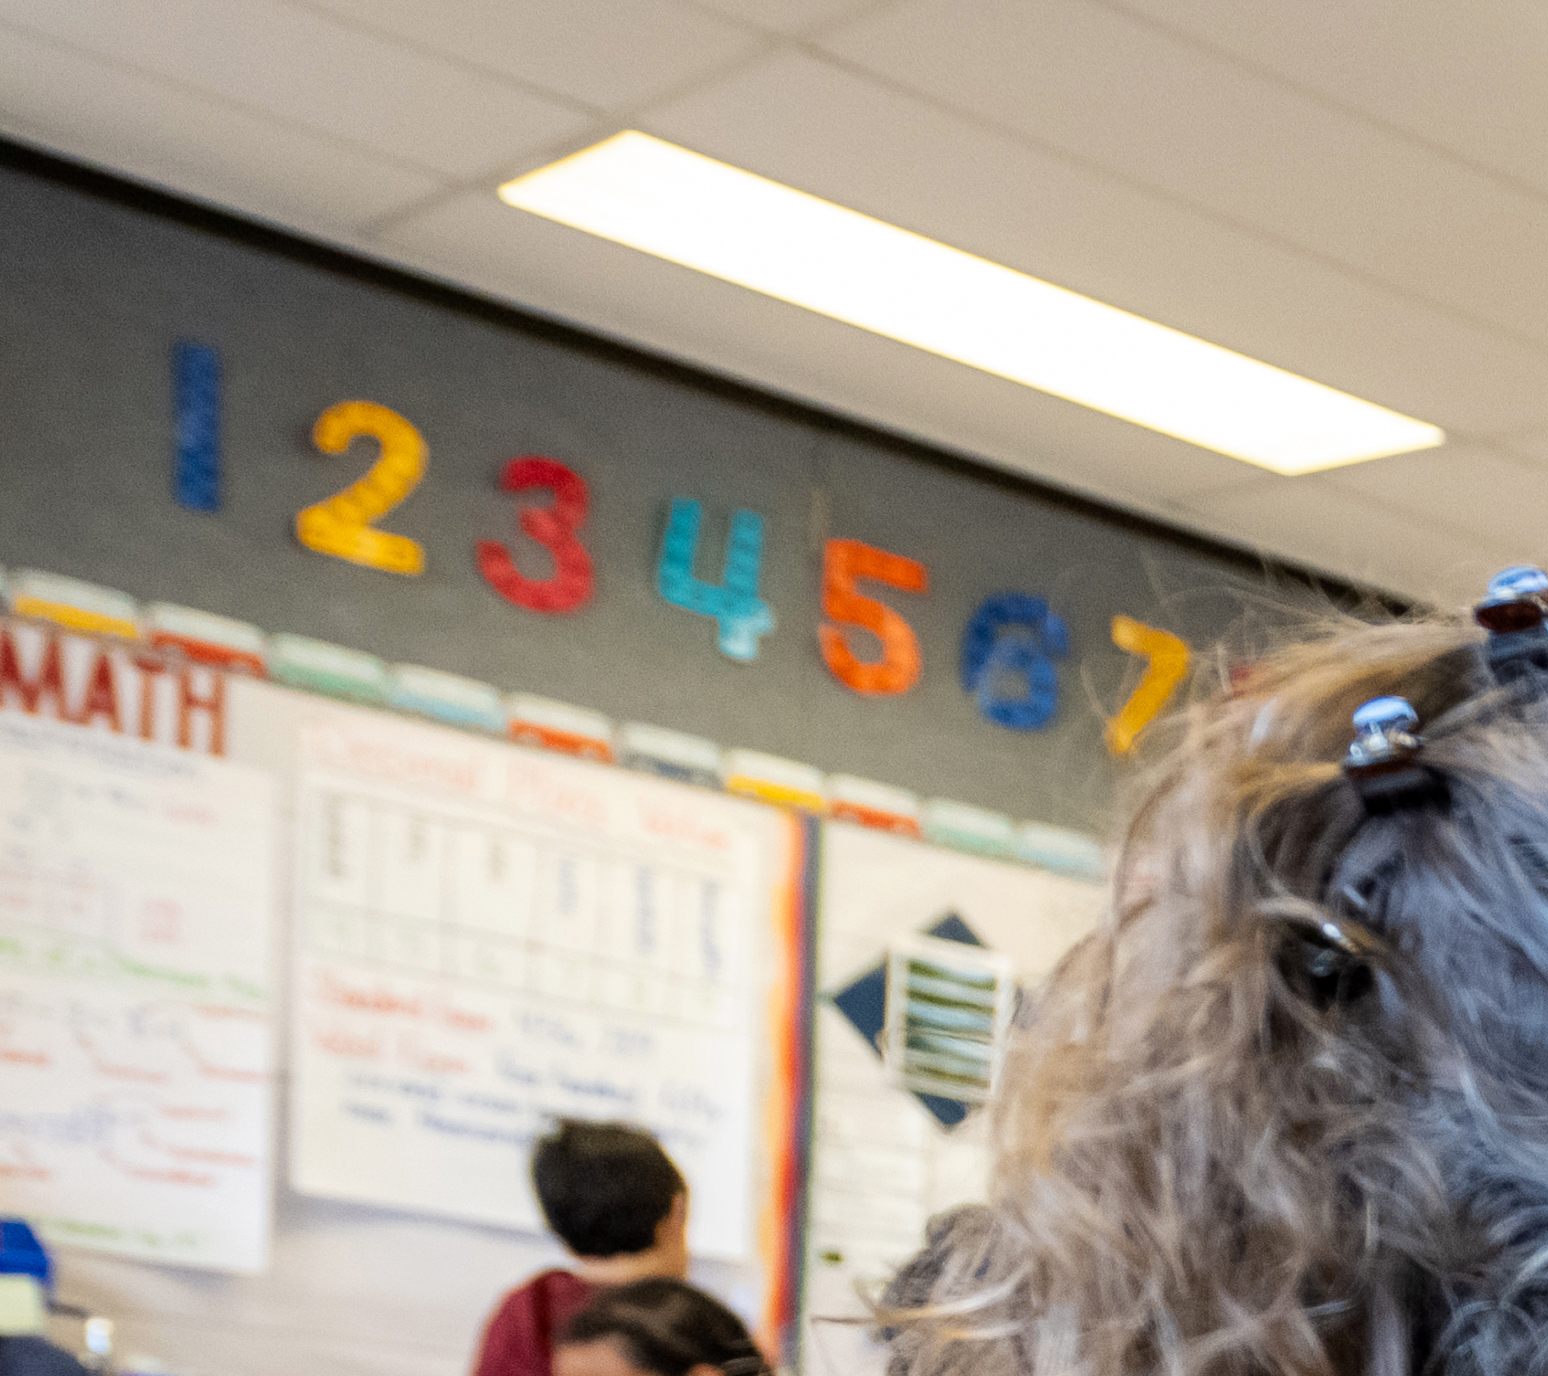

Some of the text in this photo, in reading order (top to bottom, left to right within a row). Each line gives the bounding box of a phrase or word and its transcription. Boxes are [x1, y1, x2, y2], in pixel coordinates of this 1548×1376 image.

[0, 622, 228, 760] MATH
[295, 400, 429, 576] 2
[477, 456, 594, 614] 3
[655, 496, 778, 662] 4
[817, 537, 928, 697] 5
[961, 592, 1068, 731] 6
[1105, 615, 1191, 757] 7
